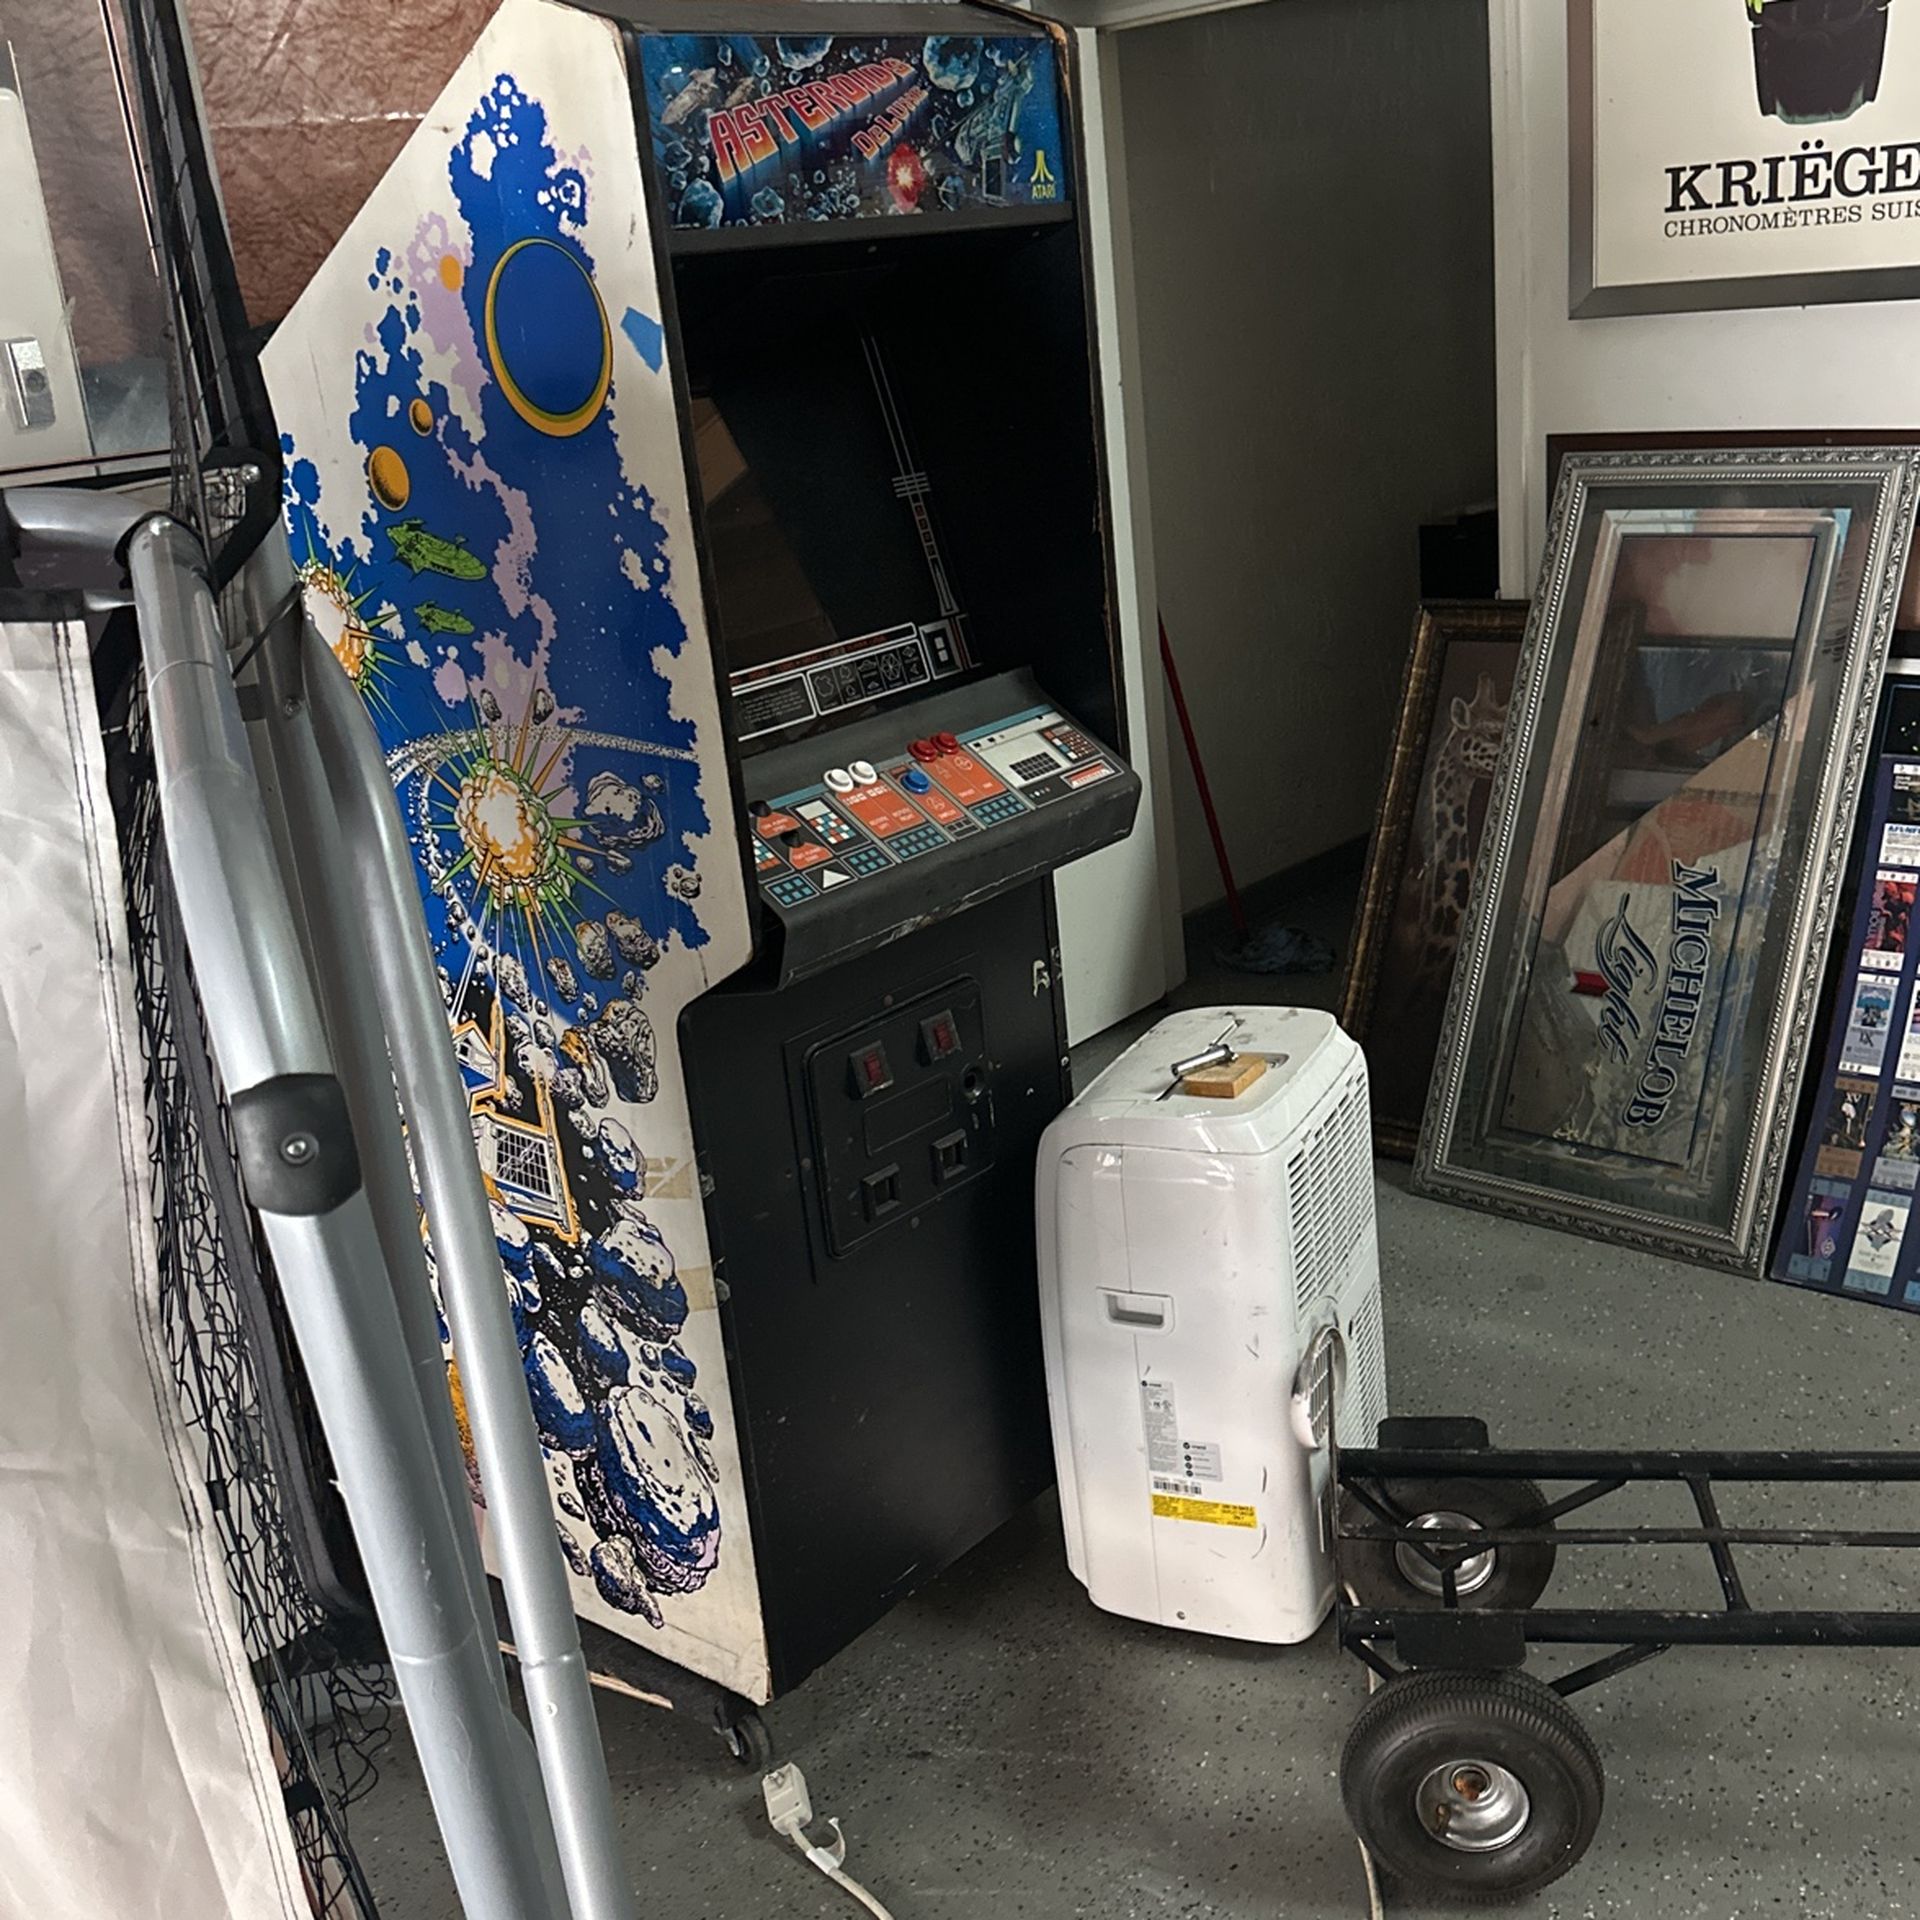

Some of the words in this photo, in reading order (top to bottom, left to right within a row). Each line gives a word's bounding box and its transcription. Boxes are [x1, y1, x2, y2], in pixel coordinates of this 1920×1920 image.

[708, 57, 915, 183] ASTEROIDS
[1031, 183, 1056, 199] ATARI
[1664, 204, 1863, 238] CHRONOMÈTRES
[1595, 891, 1659, 1065] Light
[1623, 857, 1722, 1129] MICHELOB
